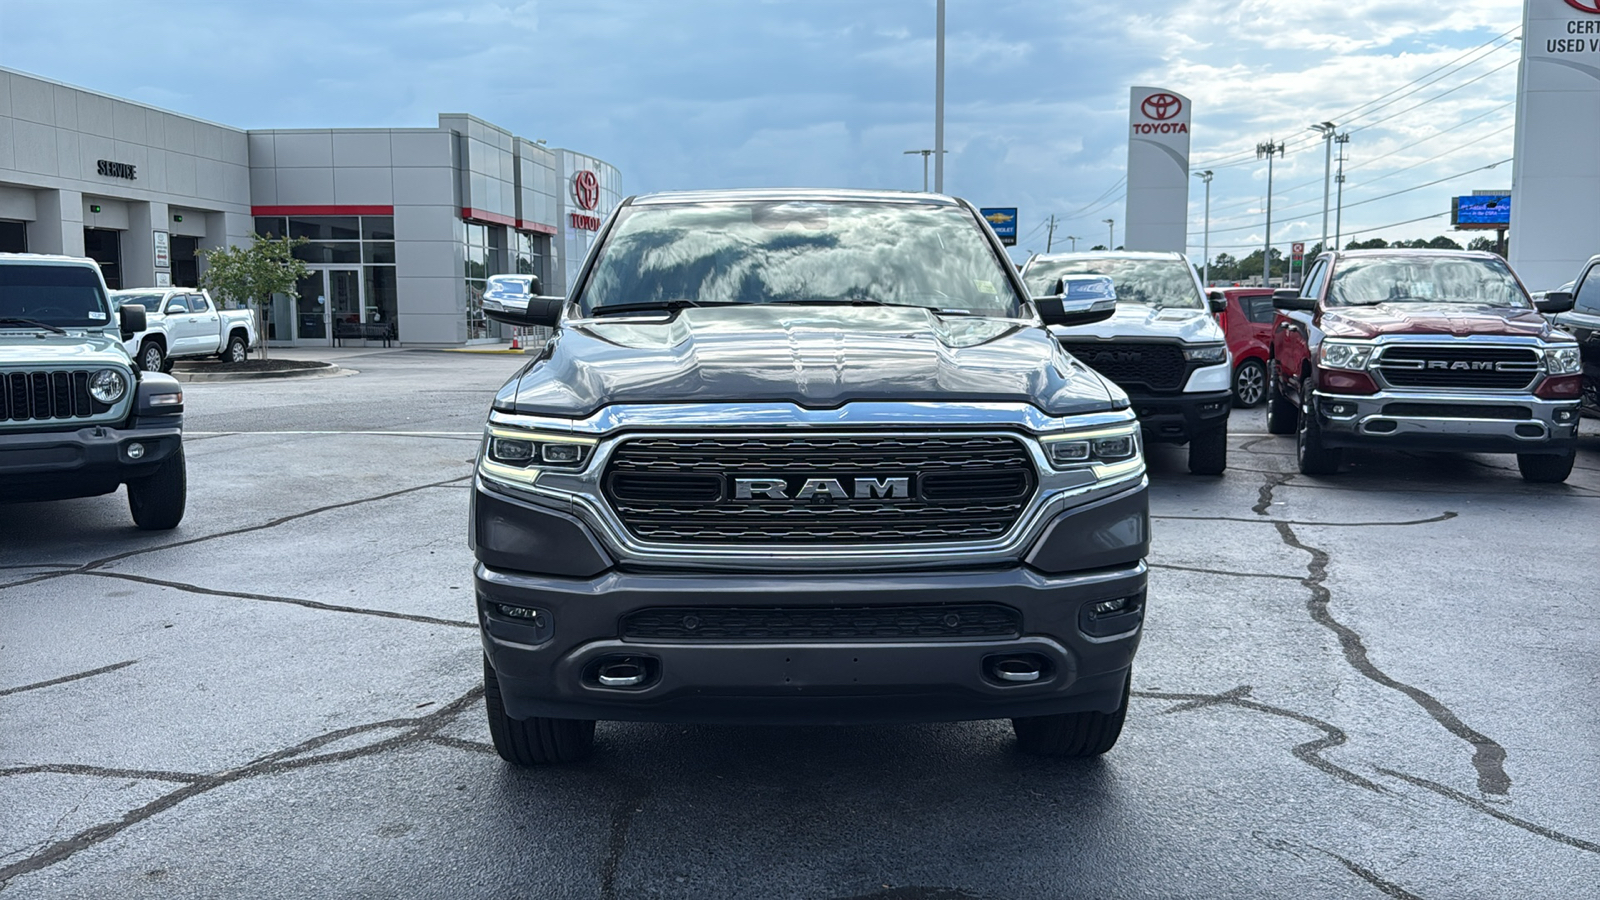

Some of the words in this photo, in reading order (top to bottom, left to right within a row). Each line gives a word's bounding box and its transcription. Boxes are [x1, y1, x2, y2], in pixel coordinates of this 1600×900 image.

[1546, 38, 1585, 53] USED
[1132, 122, 1188, 134] TOYOTA
[97, 159, 137, 180] SERVICE
[1427, 360, 1493, 370] RAM
[735, 477, 909, 499] RAM
